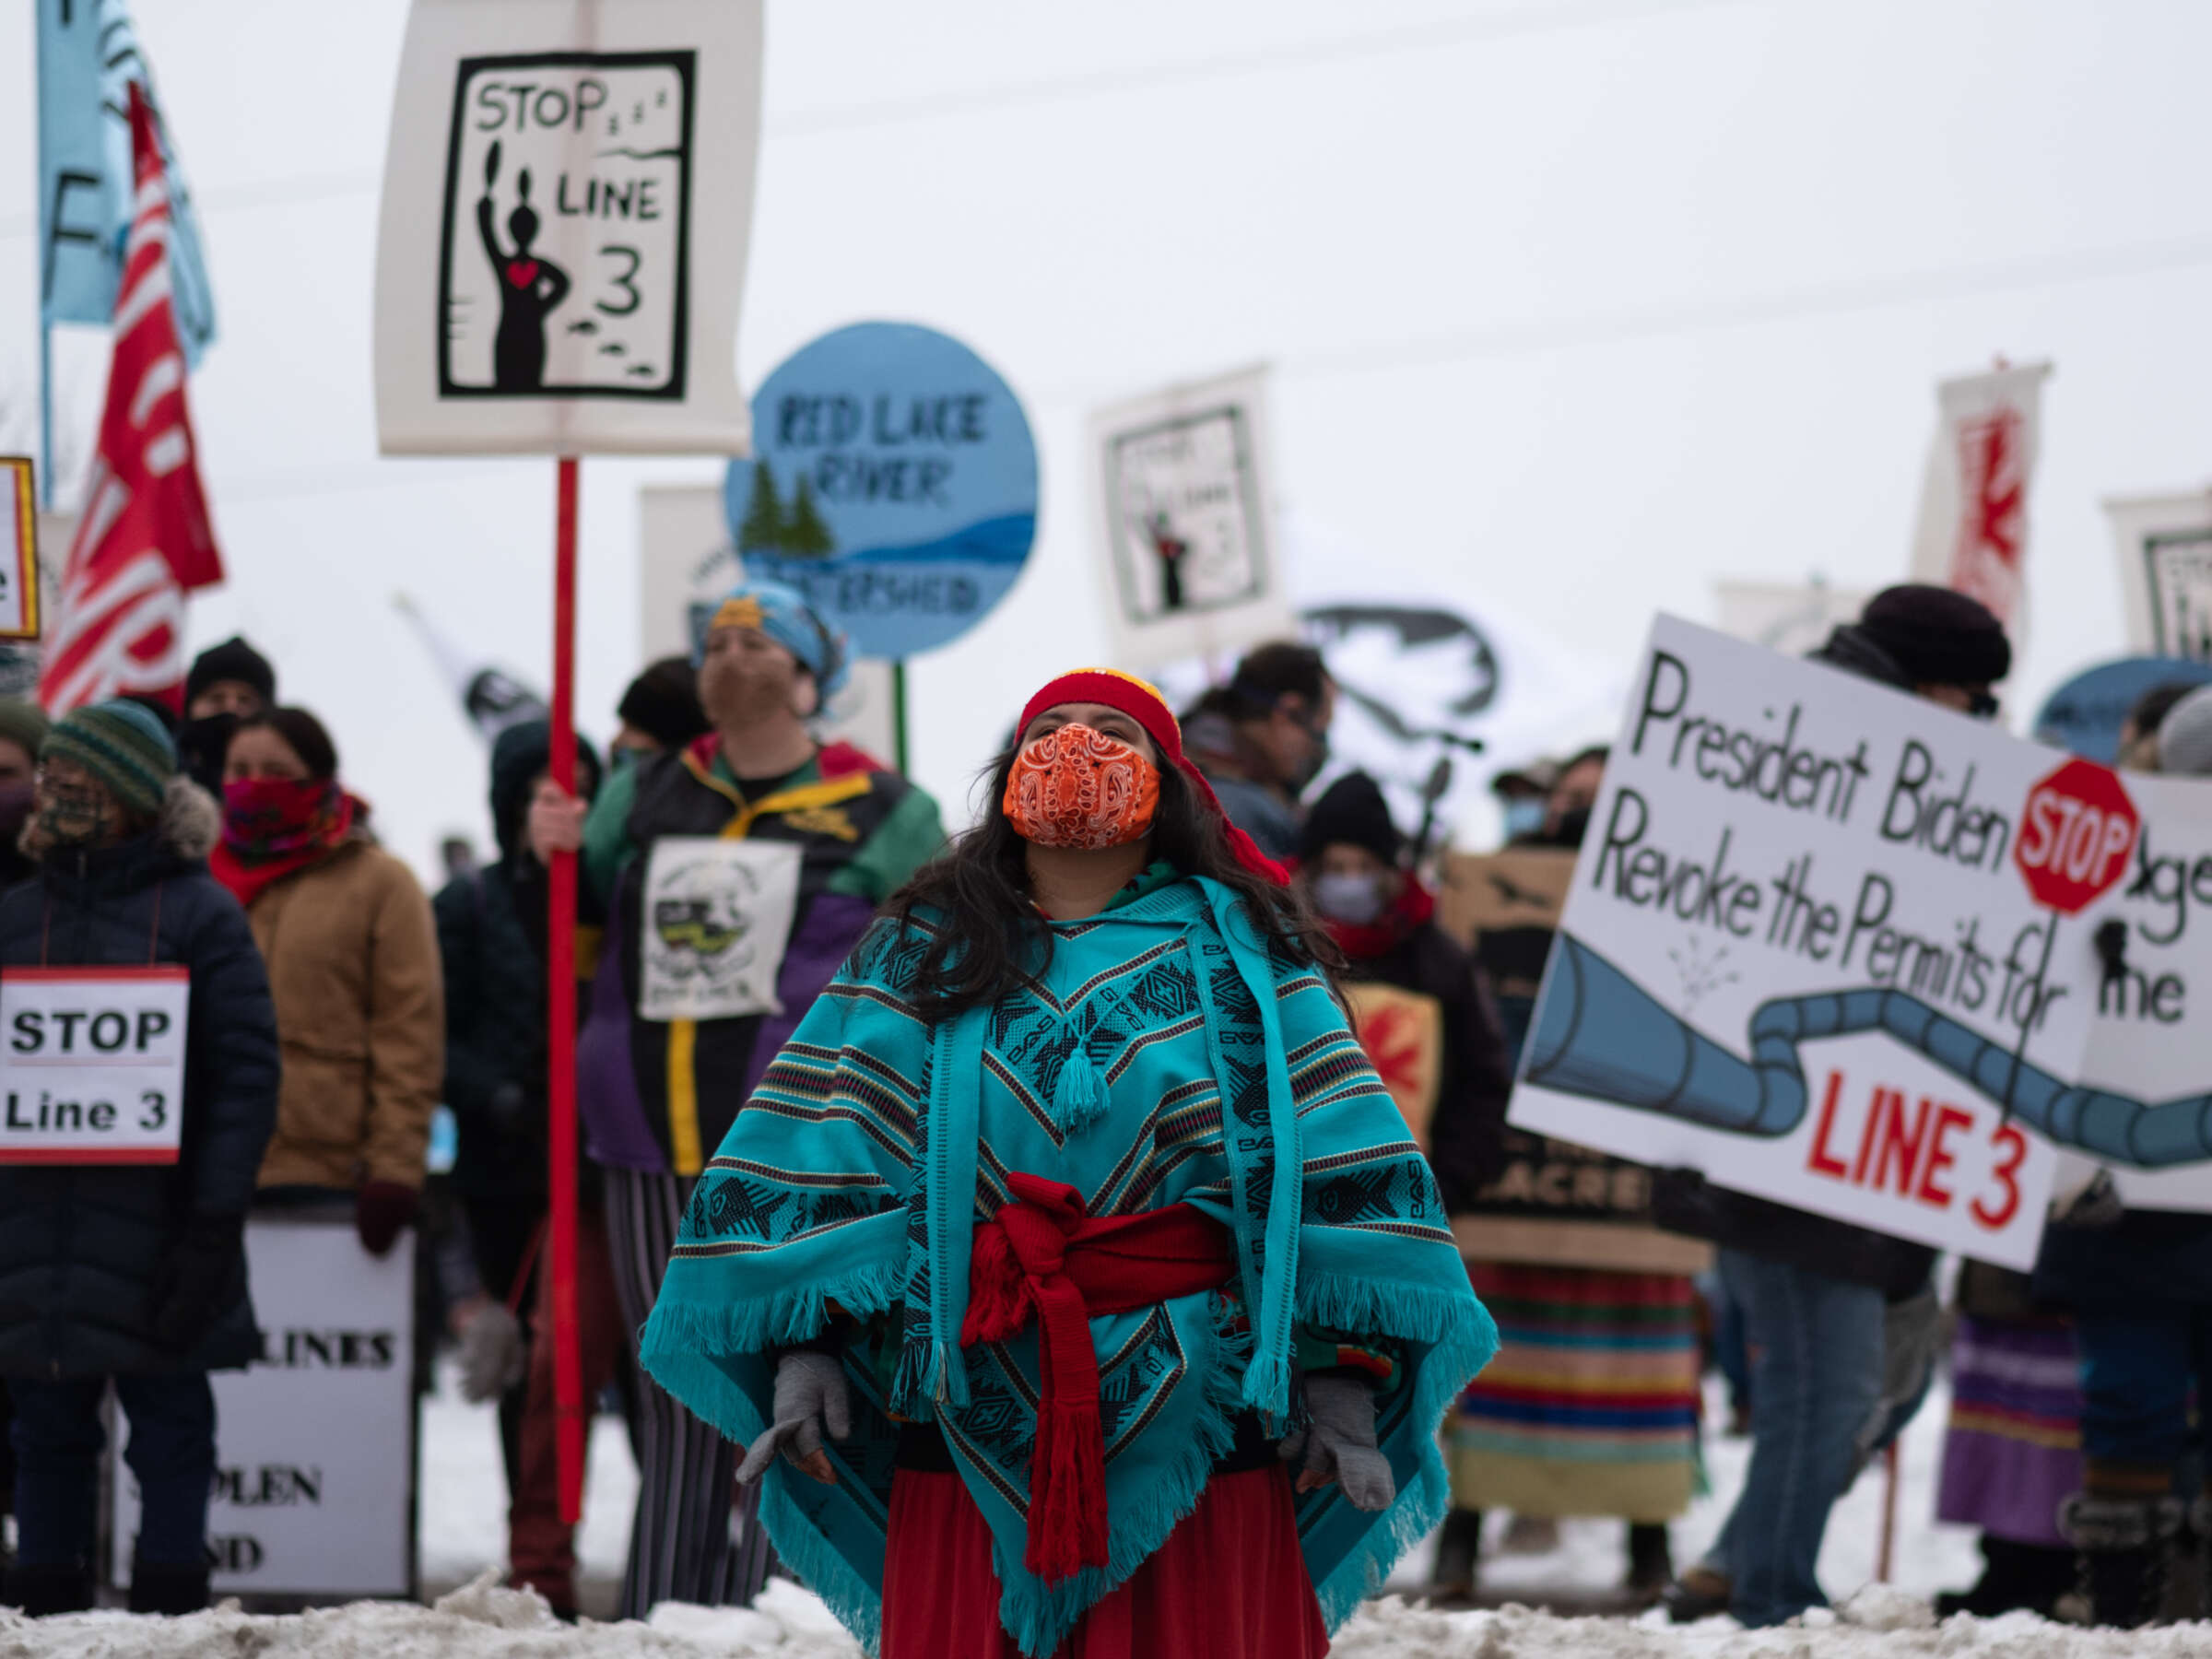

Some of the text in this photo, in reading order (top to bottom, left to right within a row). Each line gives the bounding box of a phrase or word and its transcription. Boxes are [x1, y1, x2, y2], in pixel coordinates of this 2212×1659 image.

[476, 79, 607, 132] STOP
[557, 171, 660, 220] LINE
[594, 245, 642, 317] 3
[776, 392, 987, 447] RED LAKE
[815, 455, 953, 507] RIVER
[1631, 649, 2011, 875] President Biden
[2021, 789, 2131, 887] STOP
[1593, 787, 2068, 1031] Revoke the Permits for
[11, 1010, 171, 1054] STOP
[6, 1088, 168, 1131] Line 3
[1807, 1070, 2028, 1231] LINE 3
